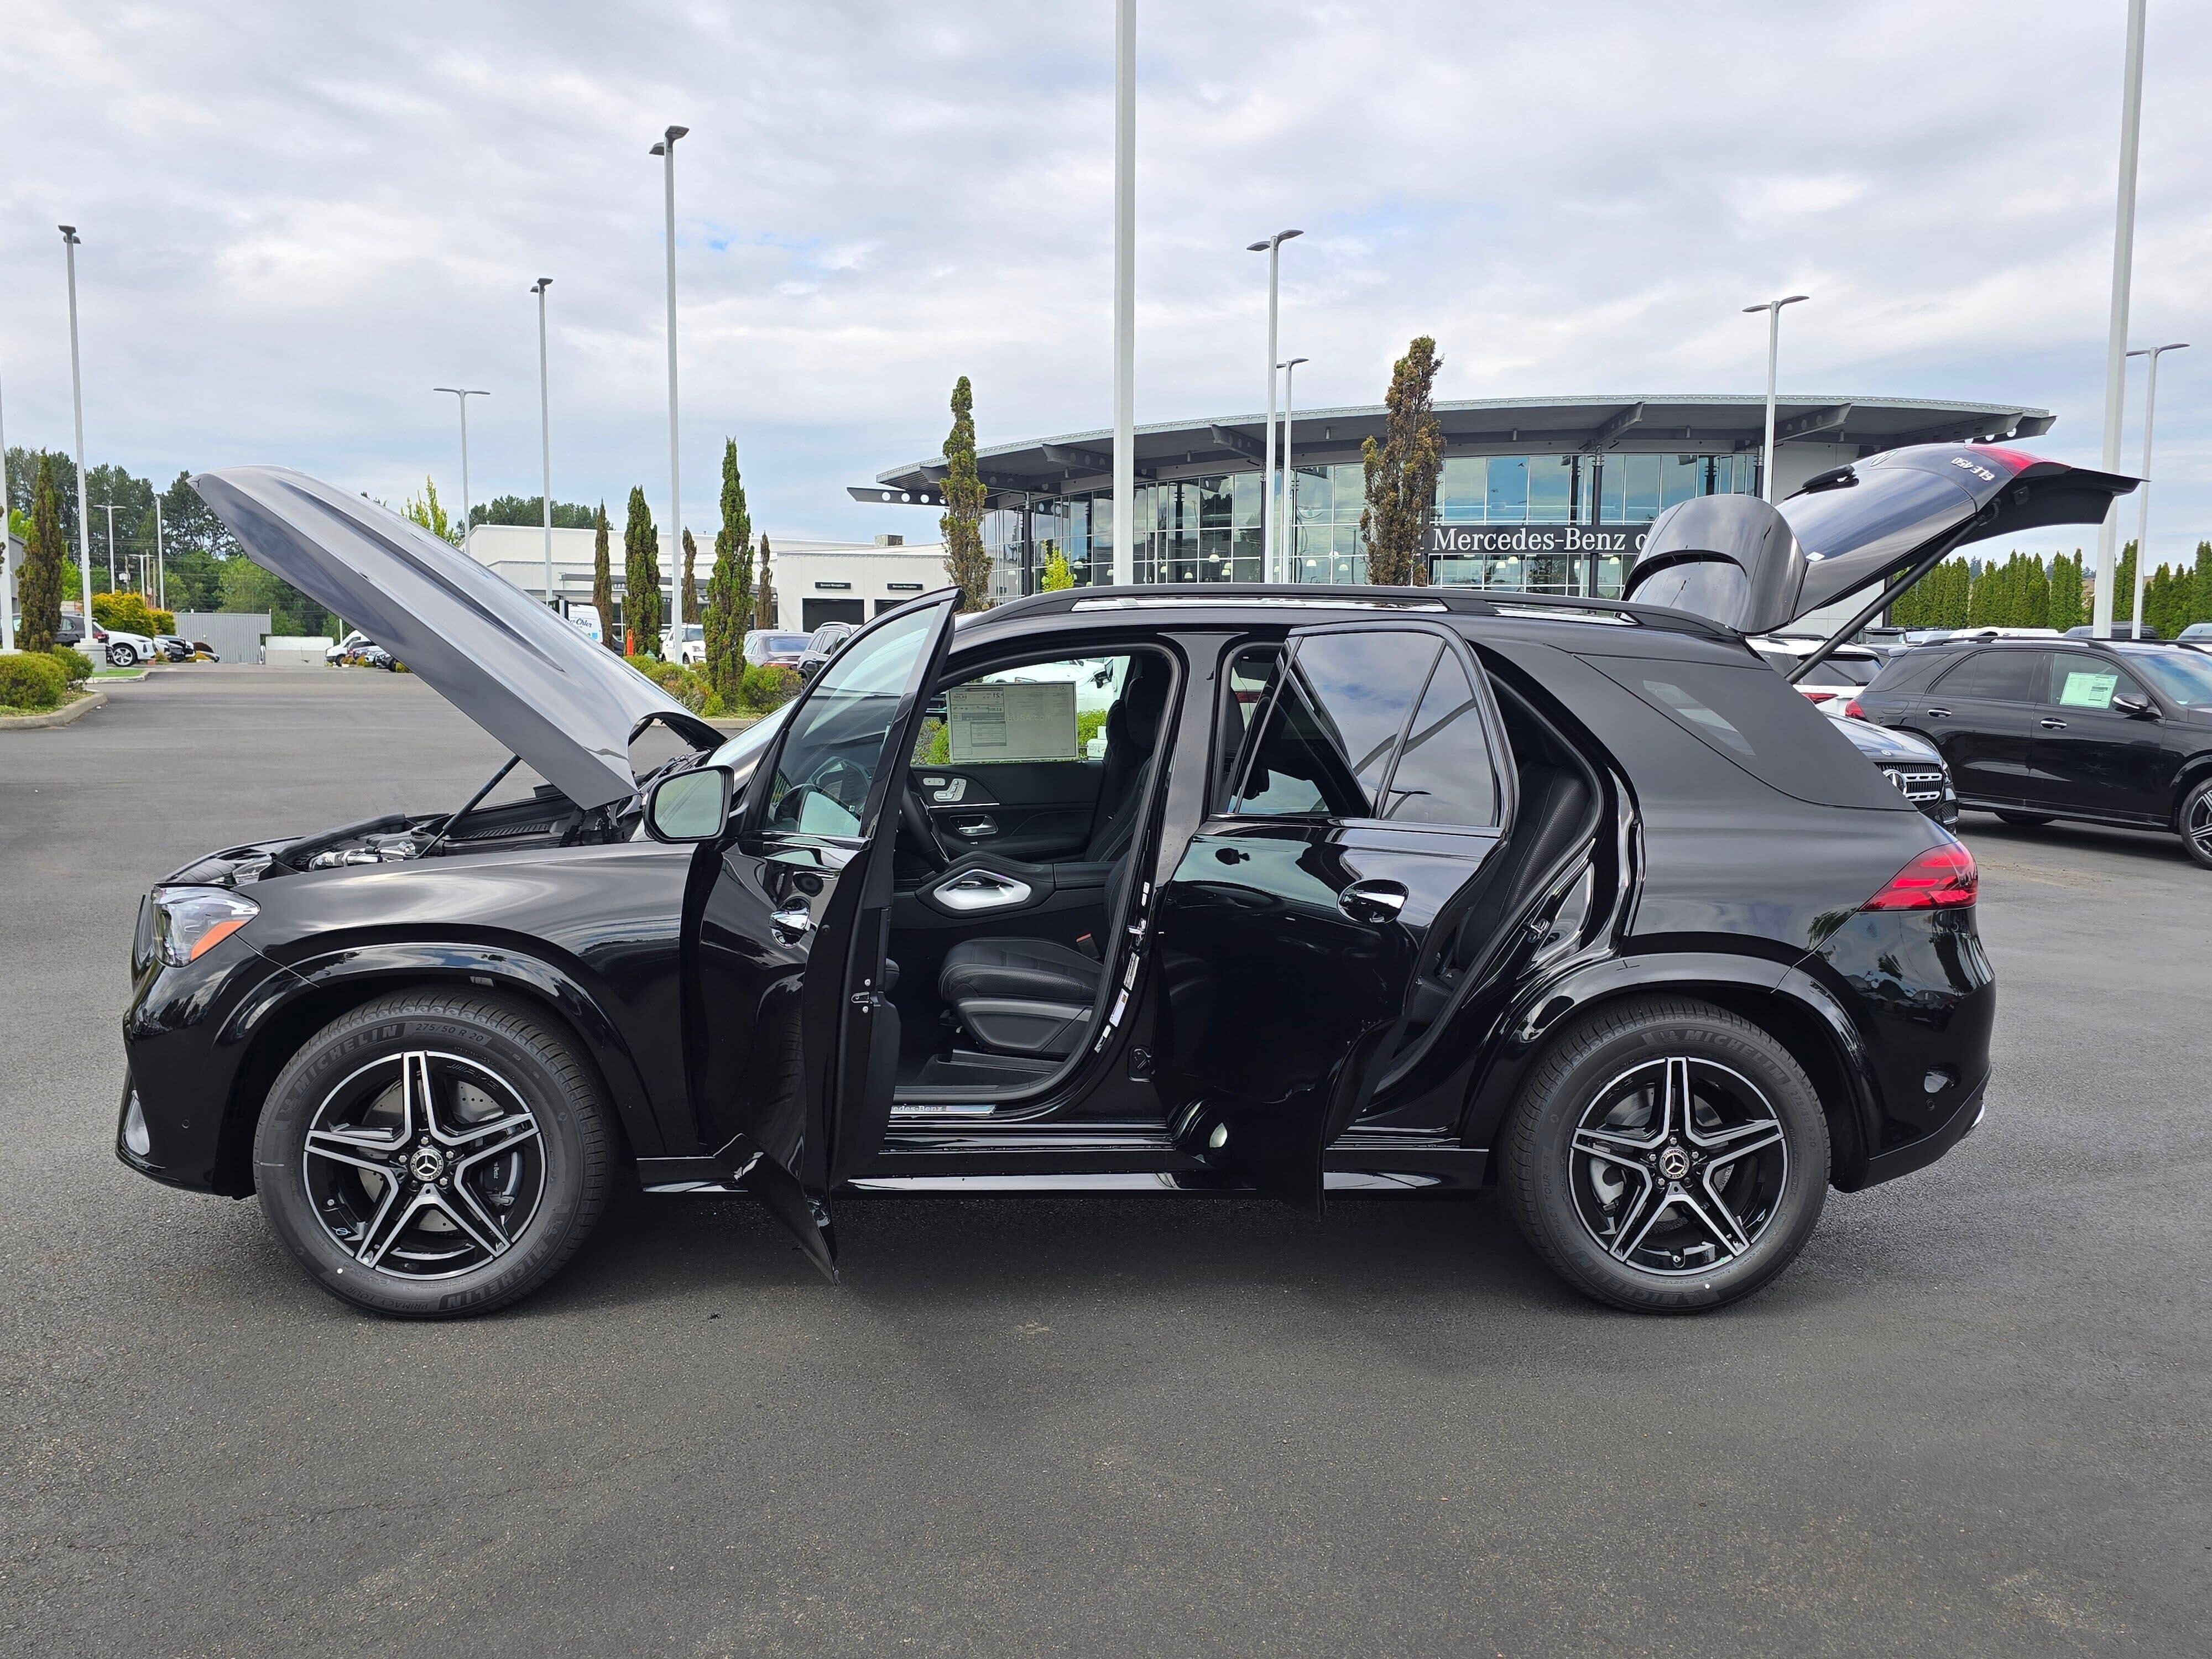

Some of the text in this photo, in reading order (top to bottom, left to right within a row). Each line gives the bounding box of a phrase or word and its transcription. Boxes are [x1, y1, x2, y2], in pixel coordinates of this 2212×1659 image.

[1950, 457, 1974, 469] 450
[1432, 527, 1626, 551] Mercedes-Benz
[415, 1023, 456, 1034] 275/50
[469, 1033, 484, 1042] 20
[294, 1025, 398, 1094] MICHELIN
[1684, 1030, 1787, 1085] MICHELIN
[1790, 1091, 1810, 1122] 275/50
[1809, 1136, 1817, 1149] 20
[1542, 1175, 1553, 1201] TOUR
[1549, 1206, 1571, 1246] PRIMACY
[447, 1241, 549, 1308] MICHELIN
[1575, 1251, 1679, 1305] MICHELIN
[346, 1286, 375, 1302] TOUR
[378, 1301, 430, 1311] PRIMACY
